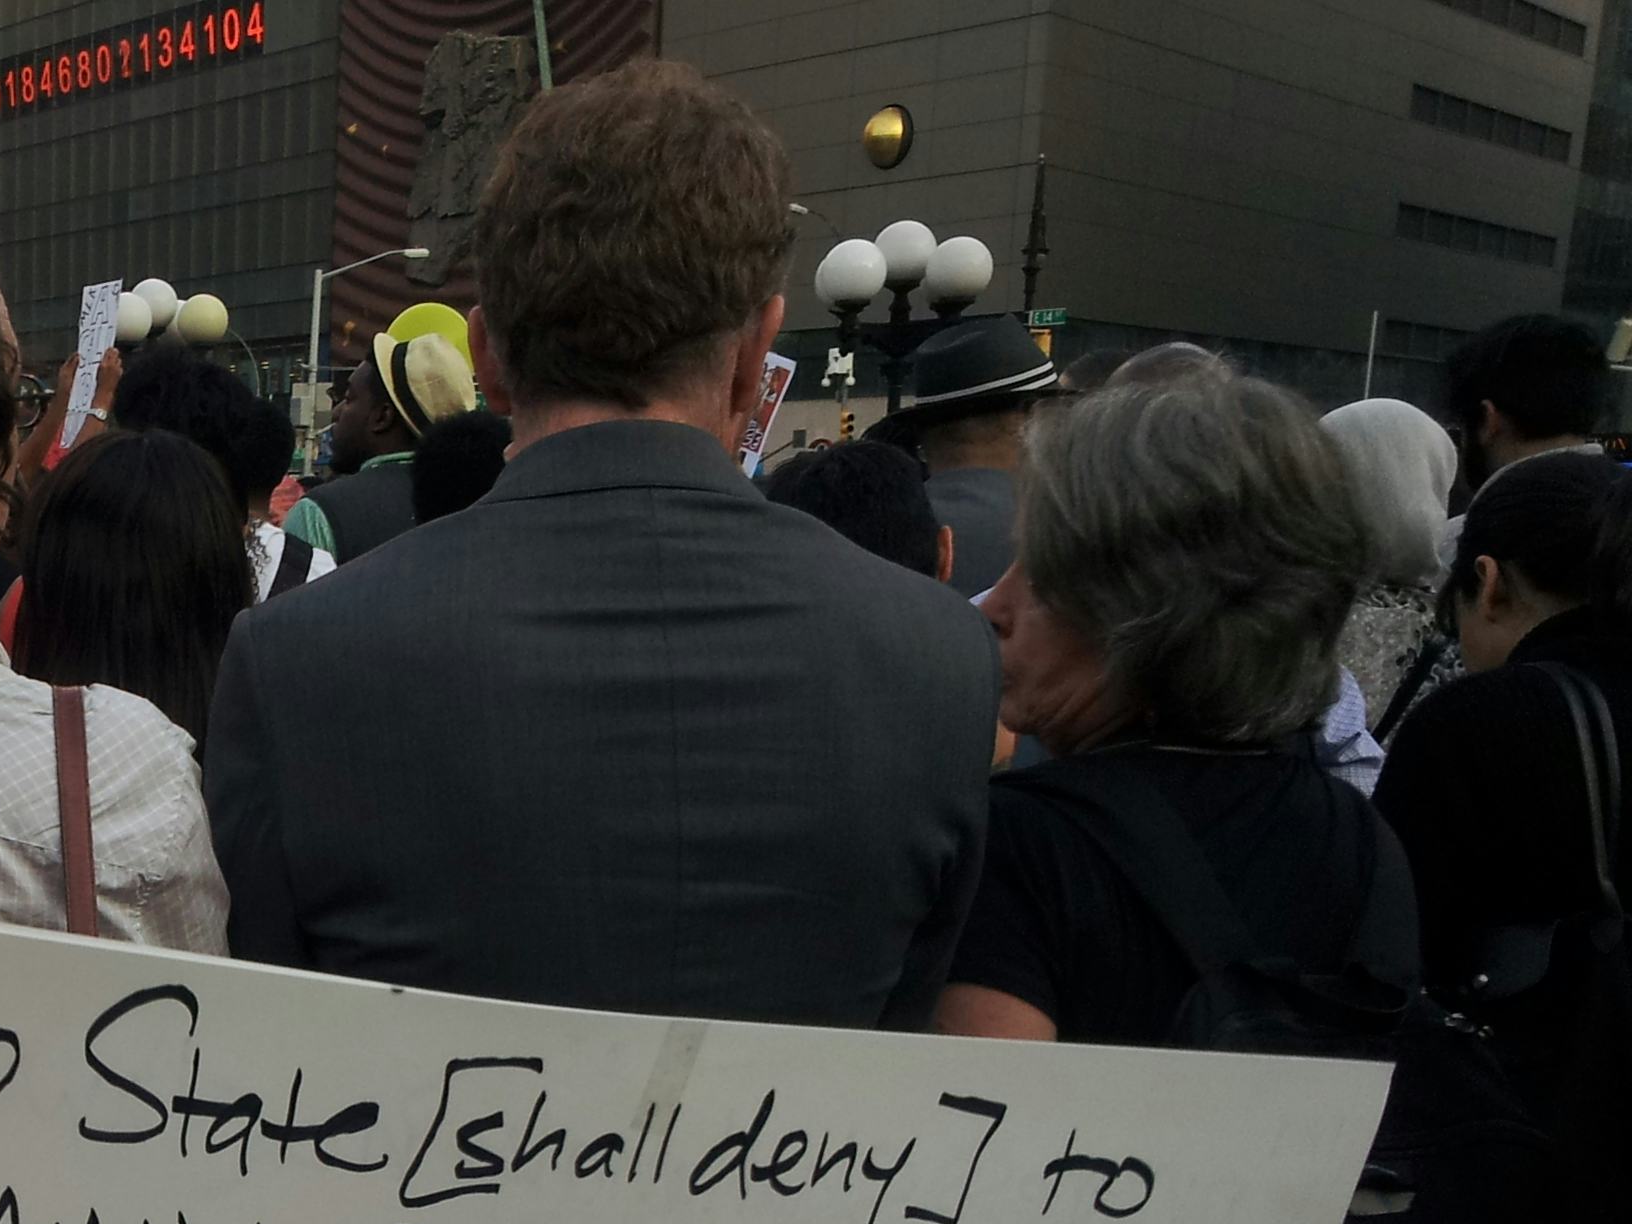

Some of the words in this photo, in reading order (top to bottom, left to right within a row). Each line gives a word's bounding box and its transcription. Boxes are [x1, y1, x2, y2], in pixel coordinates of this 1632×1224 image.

[79, 983, 389, 1176] State
[399, 1057, 681, 1208] [shall
[1042, 1129, 1155, 1218] to
